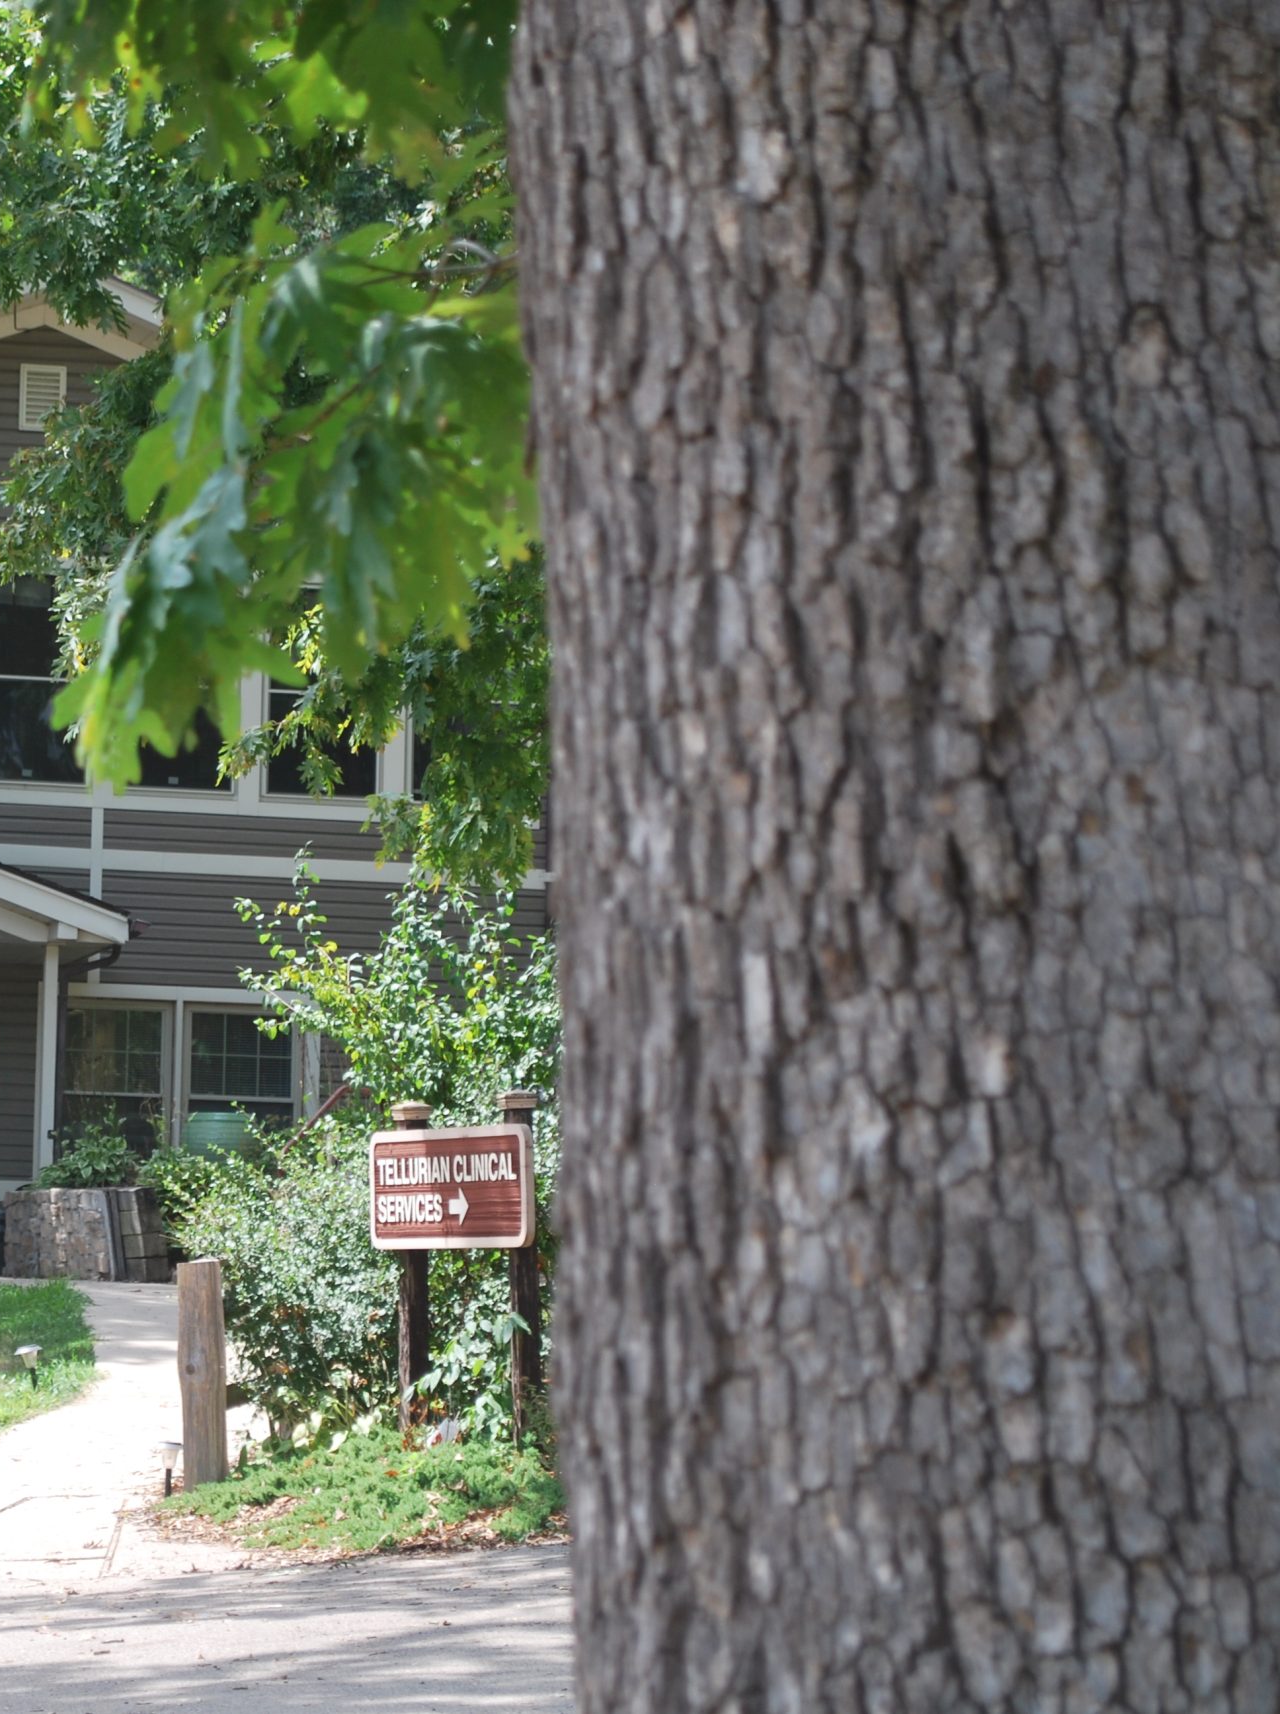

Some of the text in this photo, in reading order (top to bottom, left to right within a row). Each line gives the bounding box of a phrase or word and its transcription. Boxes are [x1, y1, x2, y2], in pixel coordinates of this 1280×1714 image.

[377, 1152, 517, 1186] TELLURIAN CLINICAL
[378, 1194, 443, 1223] SERVICES
